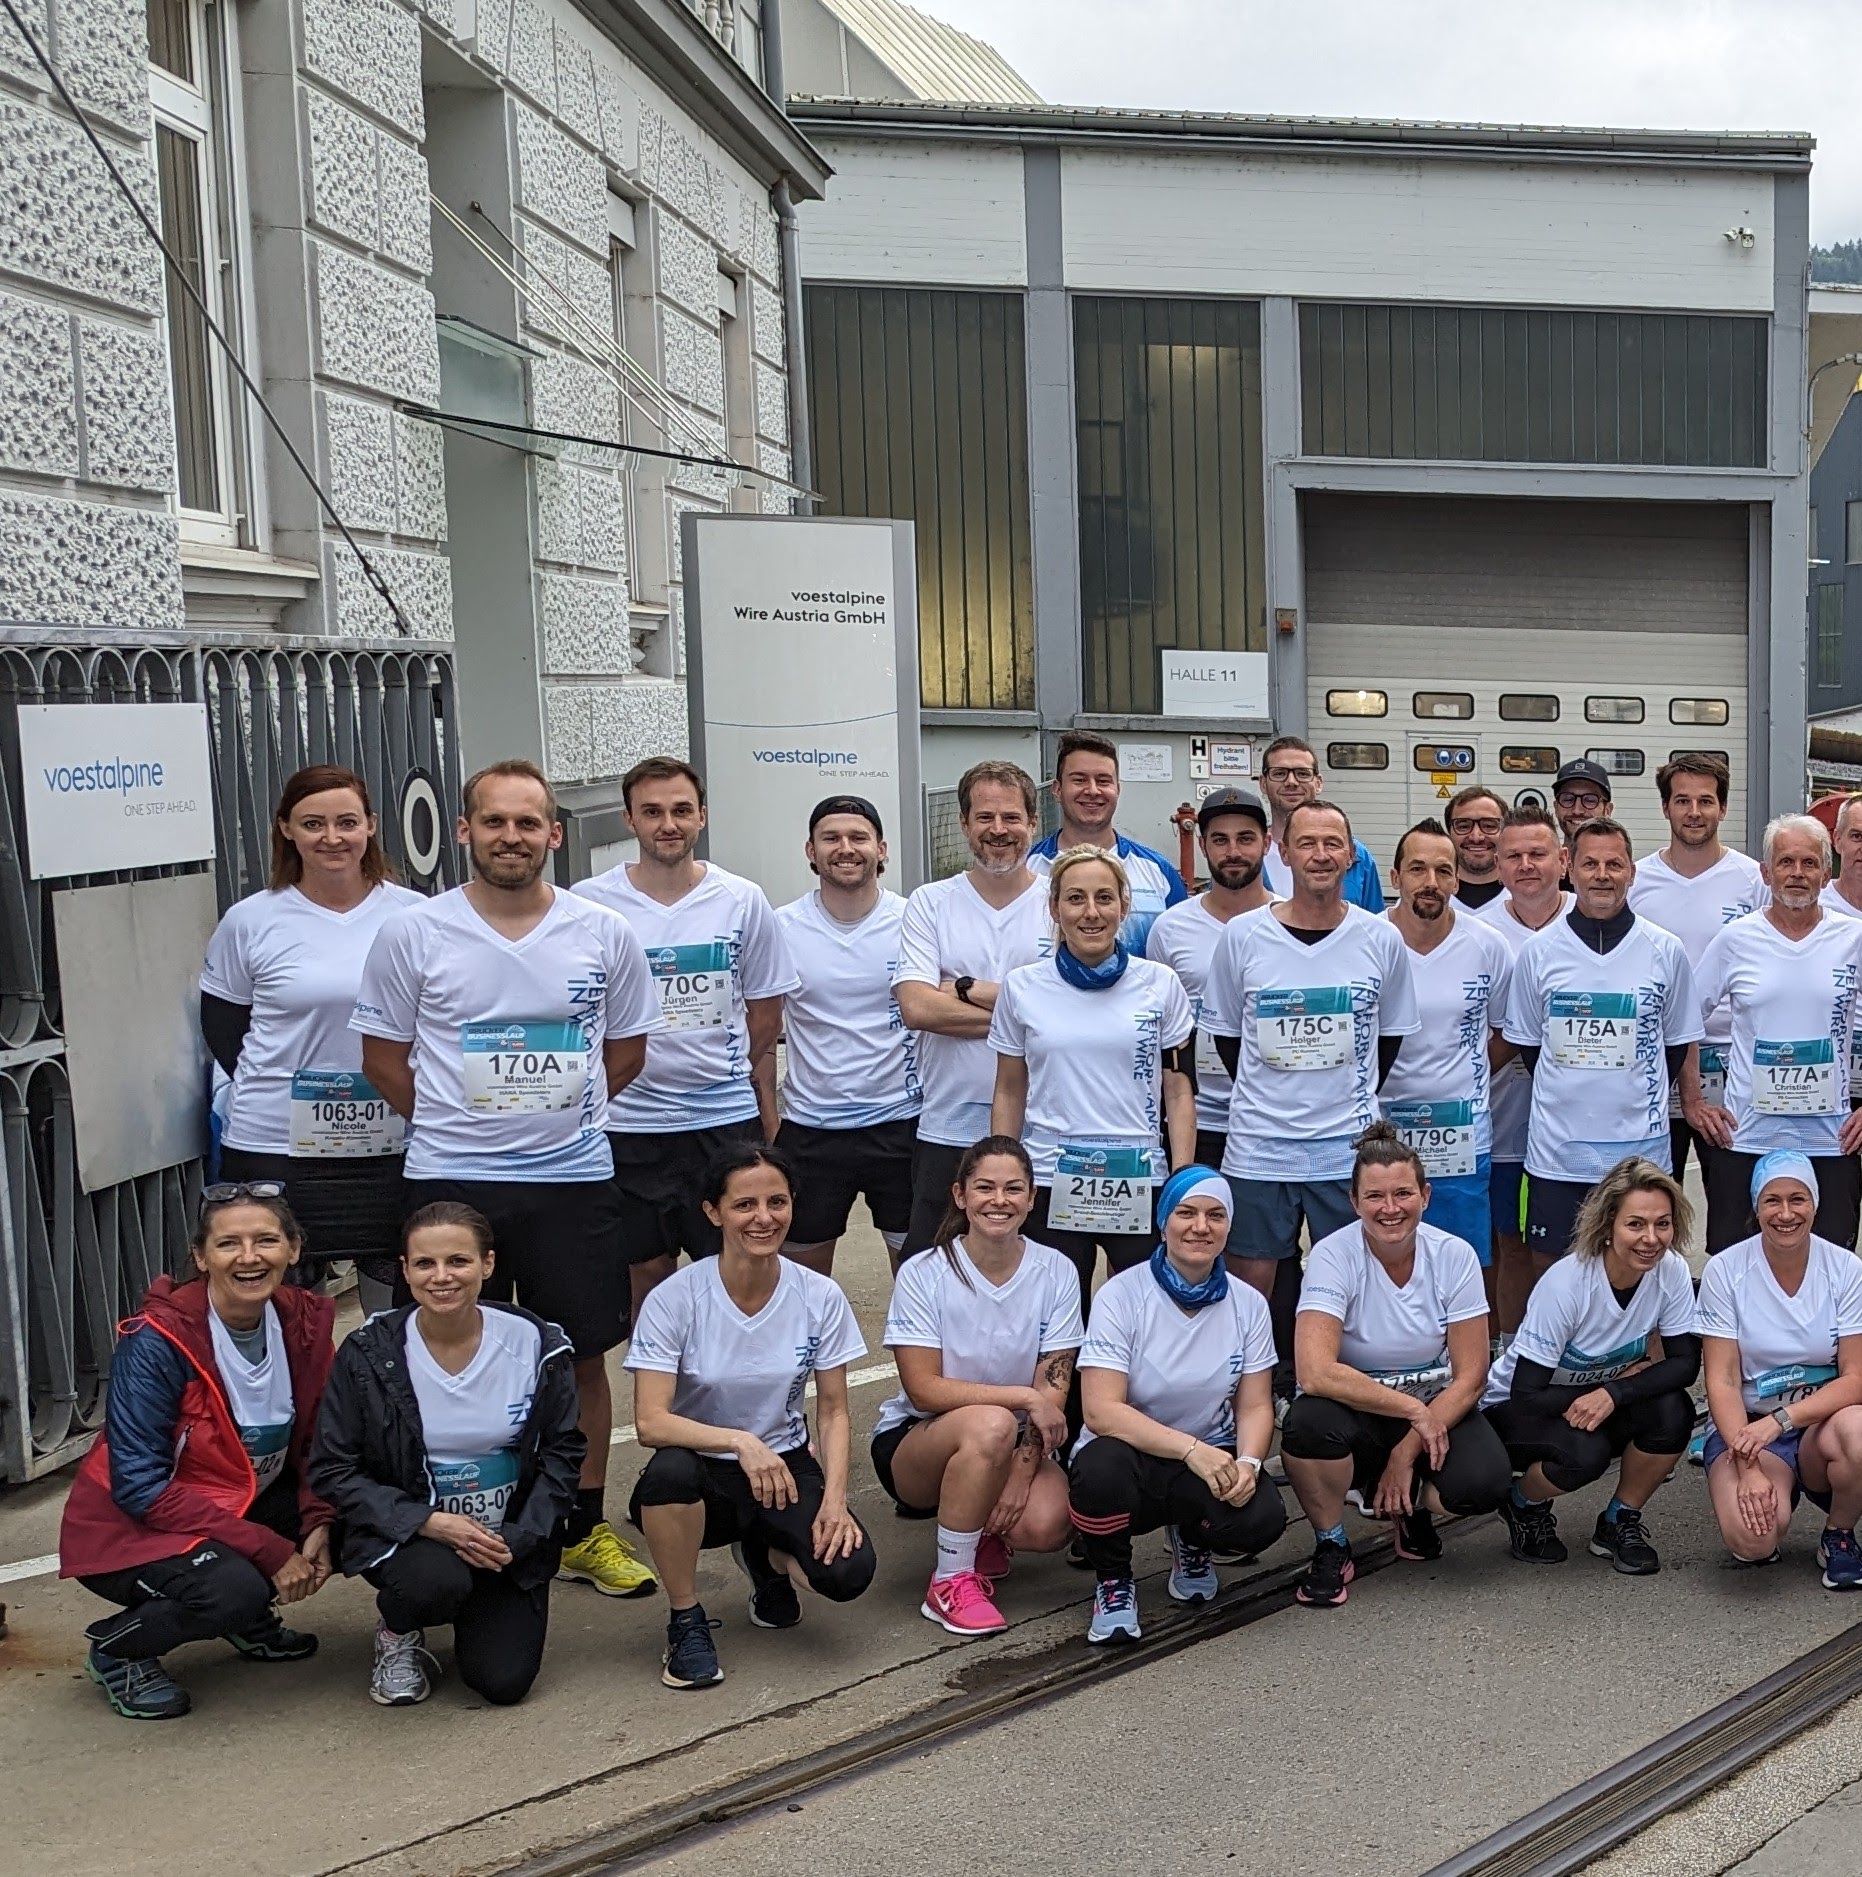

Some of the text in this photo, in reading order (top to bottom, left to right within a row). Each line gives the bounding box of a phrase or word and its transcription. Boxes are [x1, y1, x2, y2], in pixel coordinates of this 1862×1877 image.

[791, 590, 885, 607] voestalpine
[734, 606, 885, 624] Wire Austria GmbH
[1170, 668, 1237, 682] HALLE 11
[1192, 739, 1206, 756] H
[1217, 747, 1245, 755] Hydrant
[752, 749, 858, 767] voestalpine
[43, 756, 164, 797] voestalpine
[1196, 765, 1202, 774] 1
[124, 803, 144, 817] ONE
[146, 802, 165, 816] STEP
[652, 974, 709, 998] 70C
[1832, 968, 1847, 988] IN
[661, 994, 698, 1006] Jürgen
[1462, 981, 1478, 1001] IN
[1275, 1016, 1334, 1037] 175C
[1564, 1019, 1618, 1037] 175A
[1635, 986, 1653, 1060] IN WIRE
[1133, 1014, 1149, 1081] IN WIRE
[1290, 1035, 1321, 1047] Holger
[1577, 1036, 1603, 1044] Dieter
[488, 1054, 562, 1075] 170A
[1644, 981, 1666, 1133] PERFORMANCE
[504, 1075, 546, 1084] Manuel
[1767, 1066, 1819, 1084] 177A
[1774, 1083, 1812, 1091] Christian
[312, 1102, 384, 1122] 1063-01
[332, 1121, 366, 1131] Nicole
[1404, 1128, 1457, 1147] 179C
[1070, 1177, 1132, 1198] 215A
[1081, 1197, 1121, 1207] Jennifer
[1230, 1354, 1243, 1375] IN
